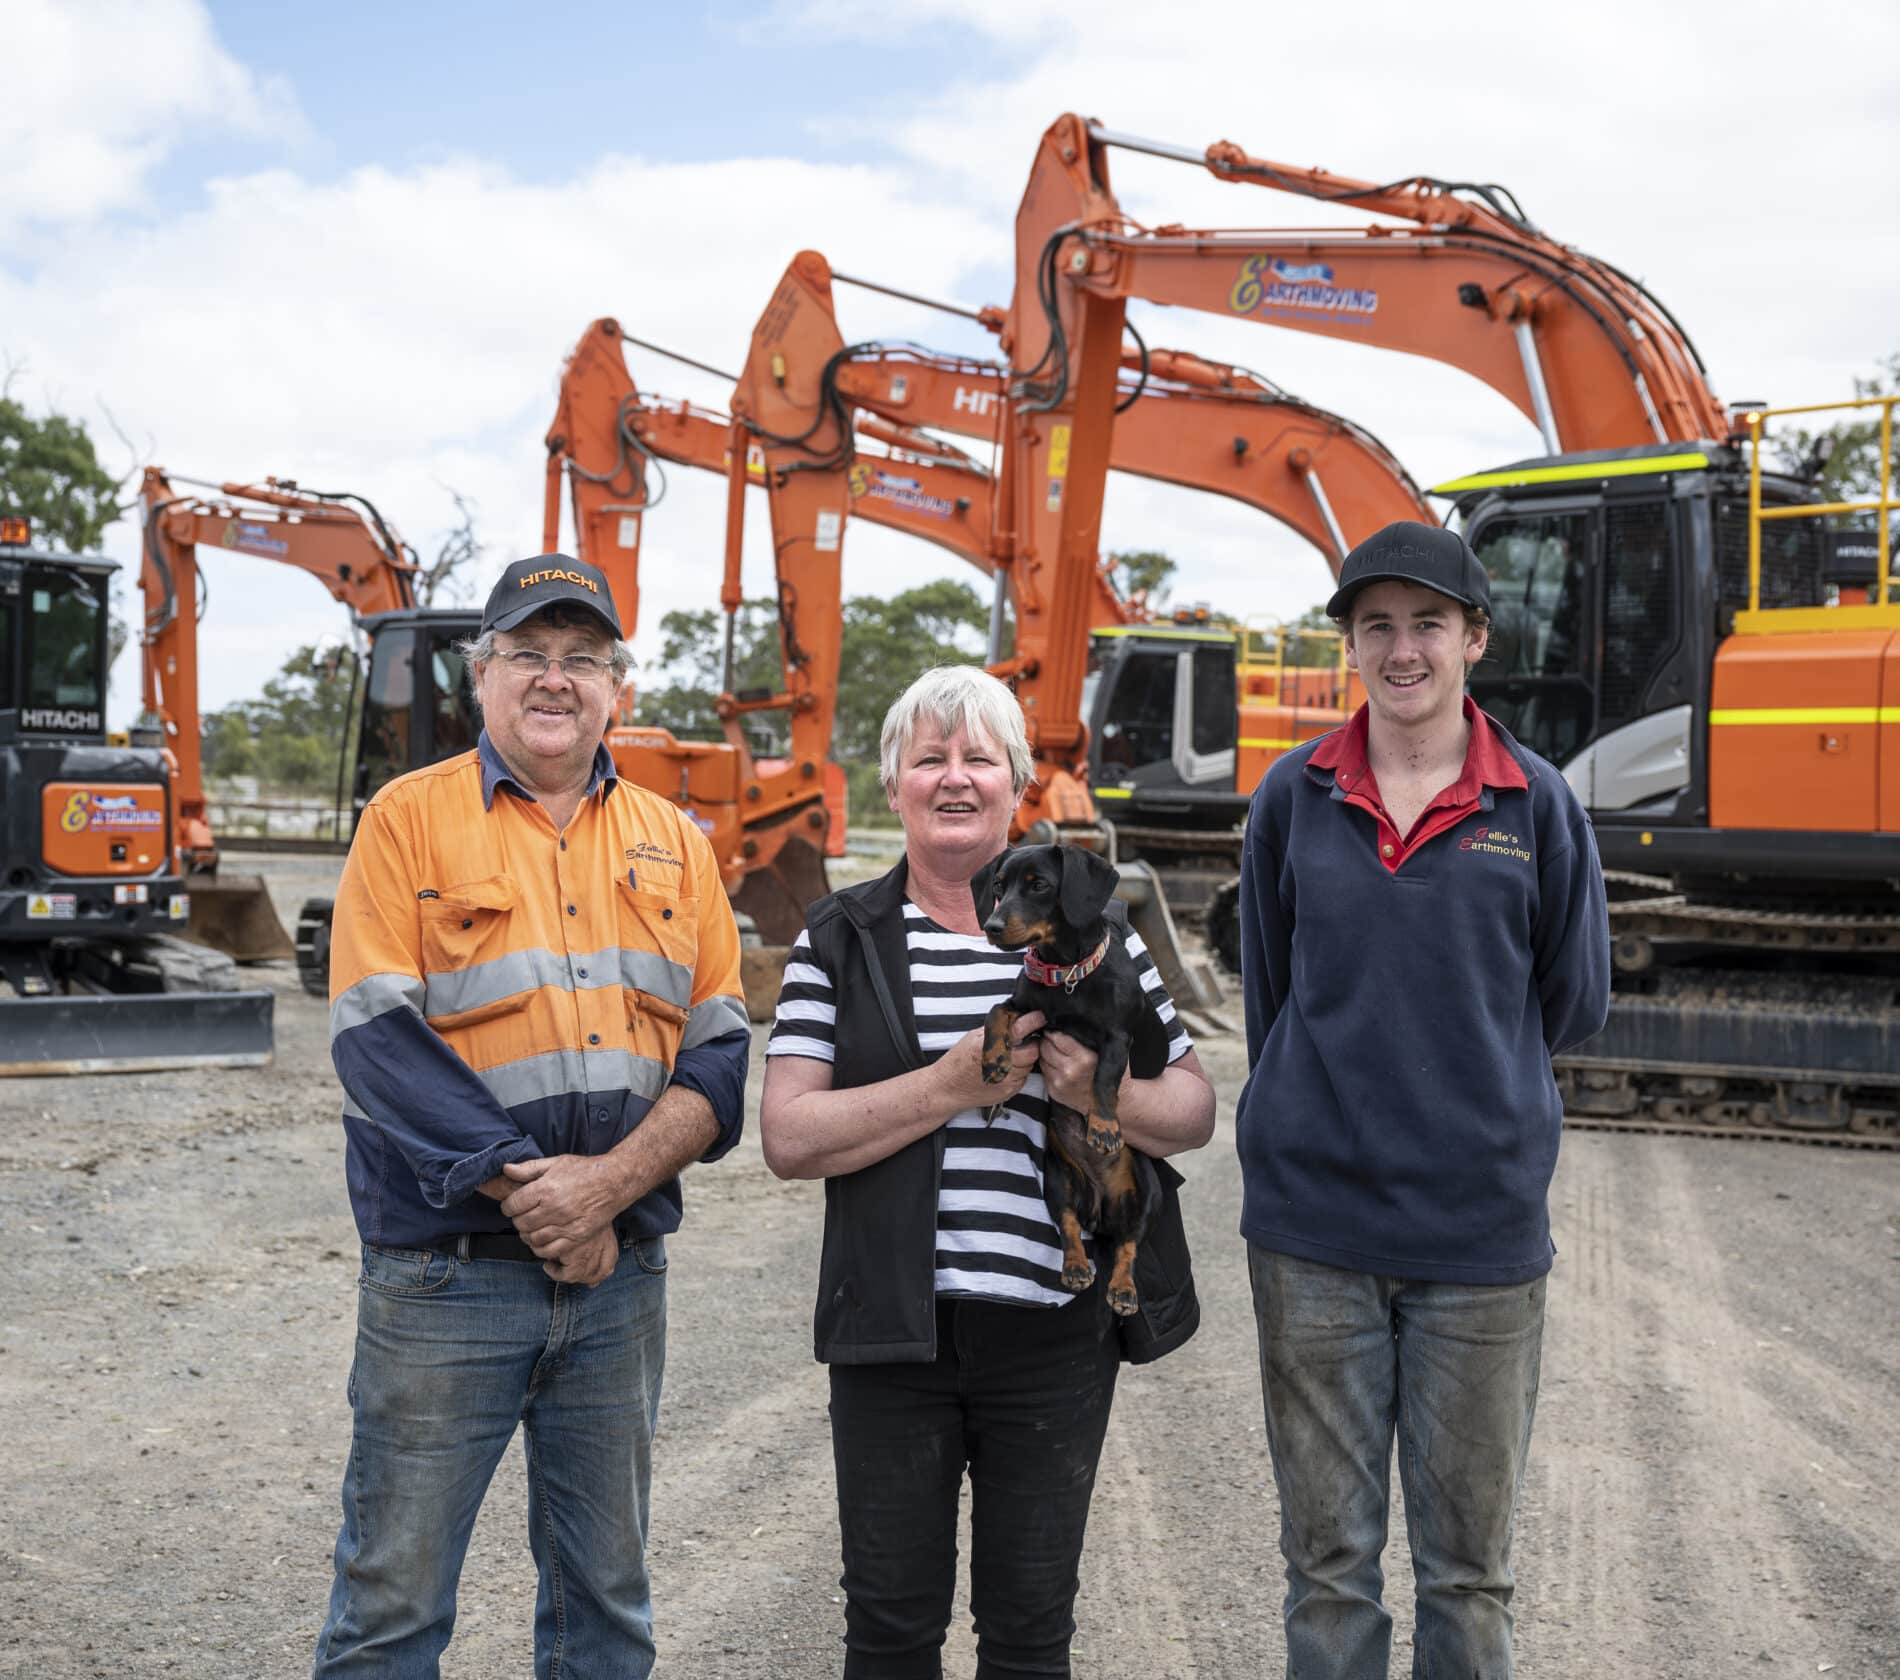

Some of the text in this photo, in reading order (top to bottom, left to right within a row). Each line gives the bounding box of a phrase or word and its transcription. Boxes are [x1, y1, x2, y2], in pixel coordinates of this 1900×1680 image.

[520, 569, 598, 593] HITACHI
[21, 708, 99, 729] HITACHI
[1458, 837, 1531, 861] Earthmoving
